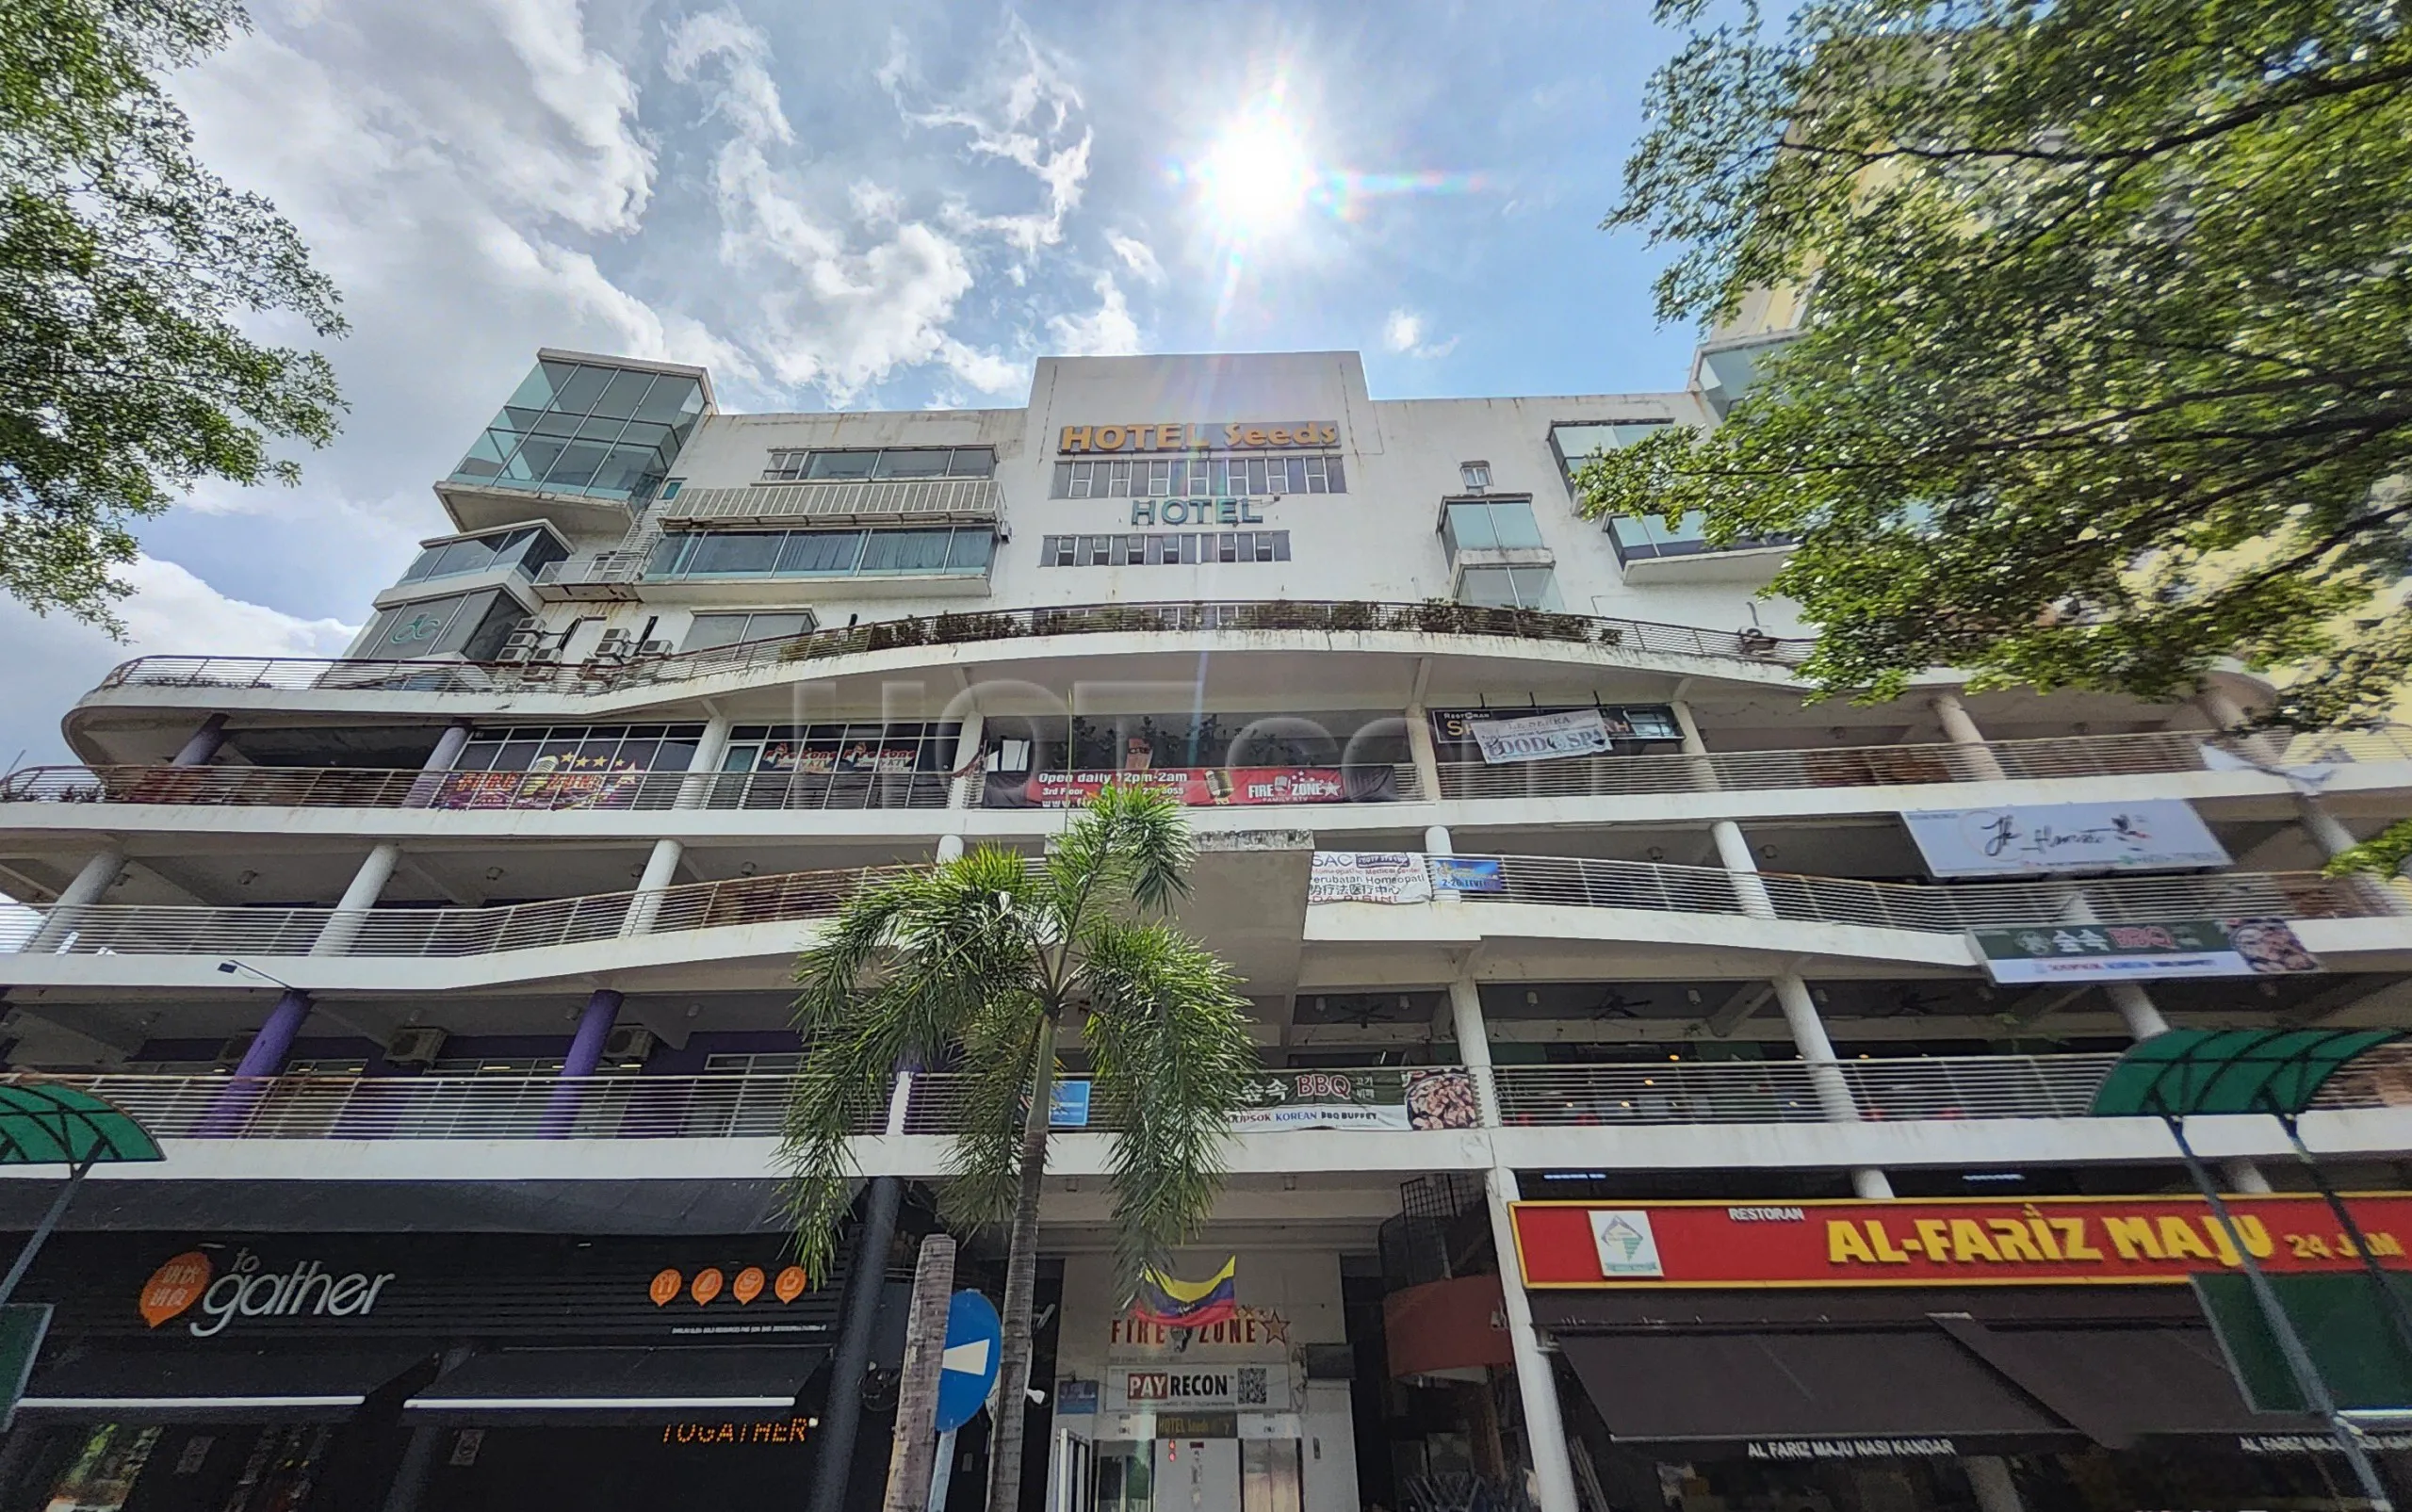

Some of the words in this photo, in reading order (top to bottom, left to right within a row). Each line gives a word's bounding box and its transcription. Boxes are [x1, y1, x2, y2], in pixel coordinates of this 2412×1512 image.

[1061, 423, 1211, 452] HOTEL
[1224, 421, 1338, 447] Seeds
[1132, 498, 1263, 526] HOTEL
[1038, 772, 1073, 784] Open
[1077, 772, 1112, 785] daily
[1116, 772, 1188, 785] 12pm-2am
[1248, 784, 1275, 799] FIRE
[1291, 783, 1322, 796] ZONE
[1311, 874, 1362, 885] erubatan
[1296, 1074, 1351, 1100] BBQ
[1275, 1112, 1317, 1122] KOREAN
[1728, 1208, 1804, 1221] RESTORAN
[2101, 1215, 2273, 1267] MAJU
[2284, 1233, 2335, 1259] 24
[232, 1246, 261, 1272] to
[189, 1260, 396, 1337] gather
[1111, 1319, 1165, 1344] FIRE
[1748, 1441, 1768, 1457] AL
[1768, 1441, 1812, 1458] FARIZ
[1812, 1440, 1854, 1457] MAJU
[1854, 1439, 1892, 1456] NASI
[1891, 1439, 1957, 1455] KANDAR
